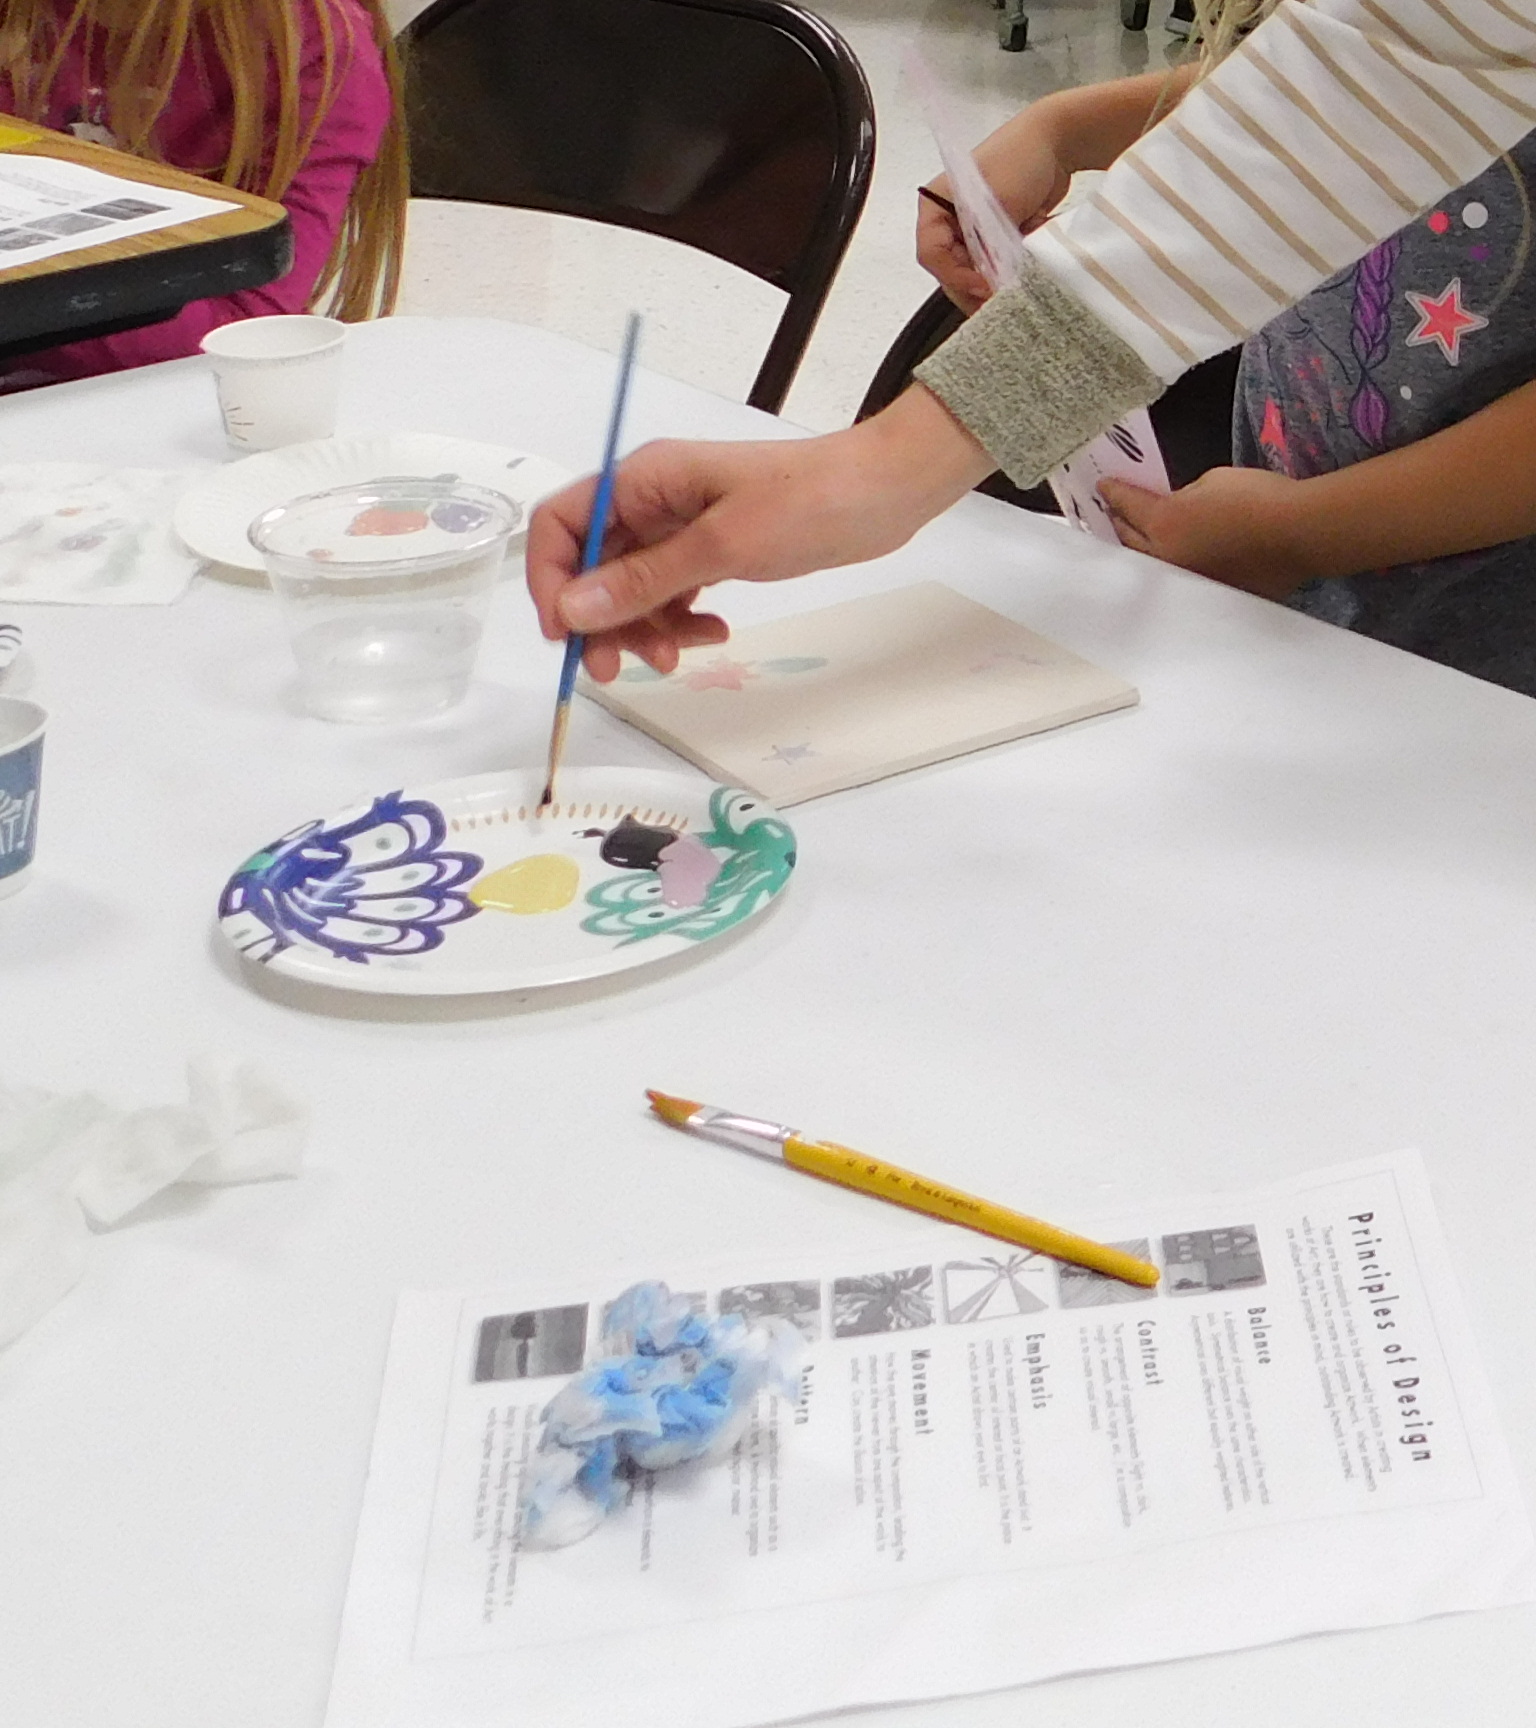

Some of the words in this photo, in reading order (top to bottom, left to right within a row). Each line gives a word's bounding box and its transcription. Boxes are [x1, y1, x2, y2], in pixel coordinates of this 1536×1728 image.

[1347, 1211, 1400, 1330] Principles
[1021, 1332, 1053, 1409] Emphasis
[1136, 1319, 1164, 1385] Contrast
[1246, 1306, 1272, 1364] Balance
[1382, 1343, 1417, 1365] of
[910, 1348, 934, 1434] Movement
[1391, 1376, 1434, 1461] Design
